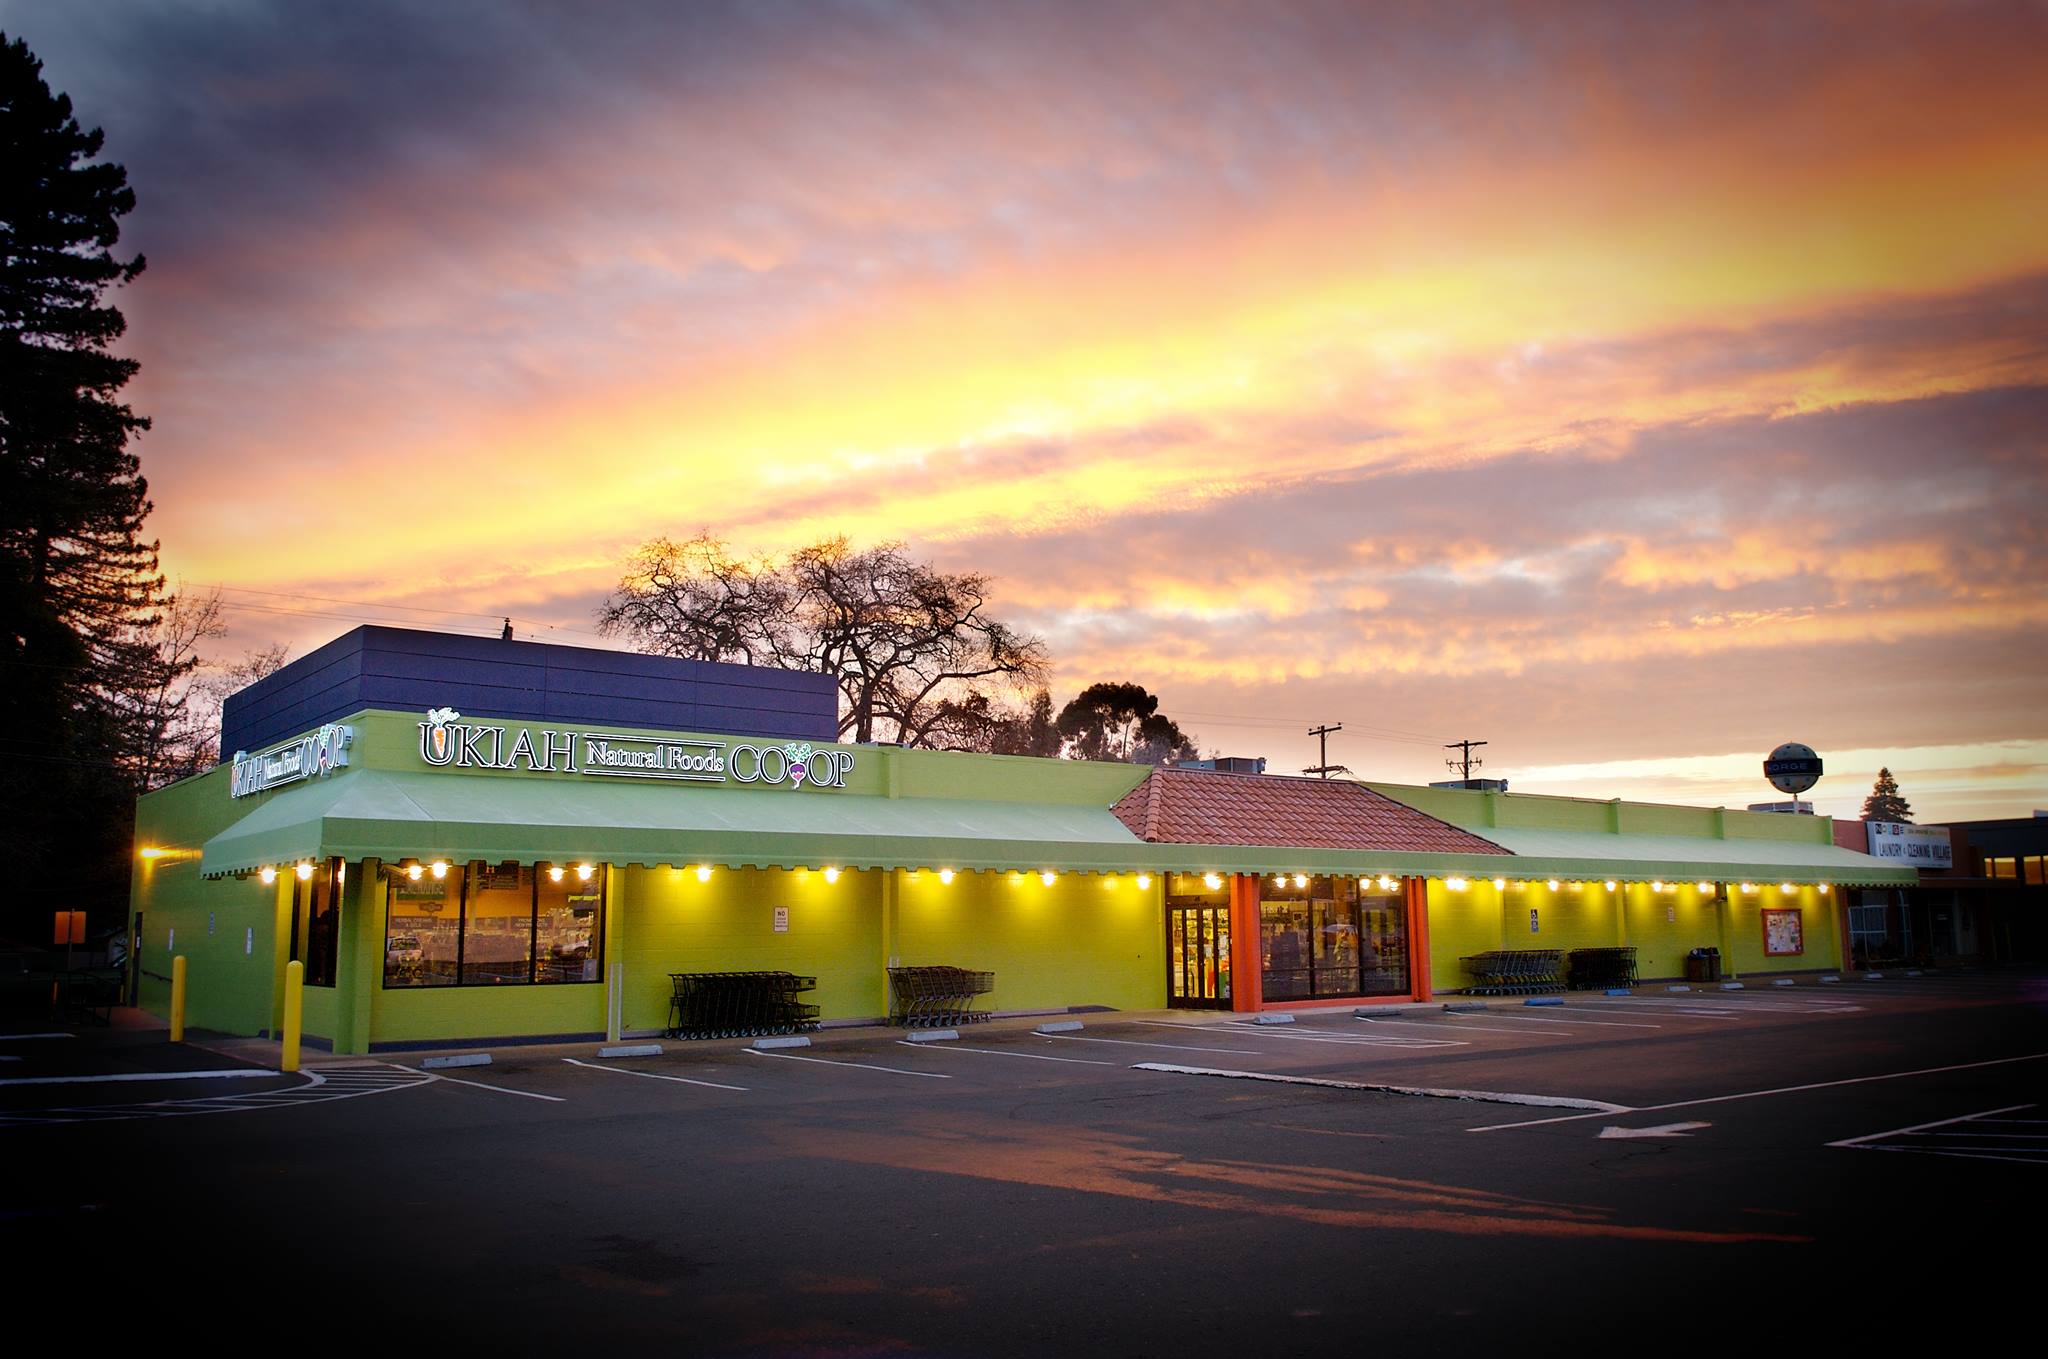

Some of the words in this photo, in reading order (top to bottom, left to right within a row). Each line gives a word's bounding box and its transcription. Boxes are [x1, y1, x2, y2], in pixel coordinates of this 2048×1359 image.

[418, 721, 578, 773] UKIAH
[586, 742, 663, 769] Natural
[668, 747, 724, 772] Foods
[231, 755, 264, 799] UKIAH
[1879, 842, 1902, 857] LAUNDRY
[1907, 843, 1930, 858] CLEANING
